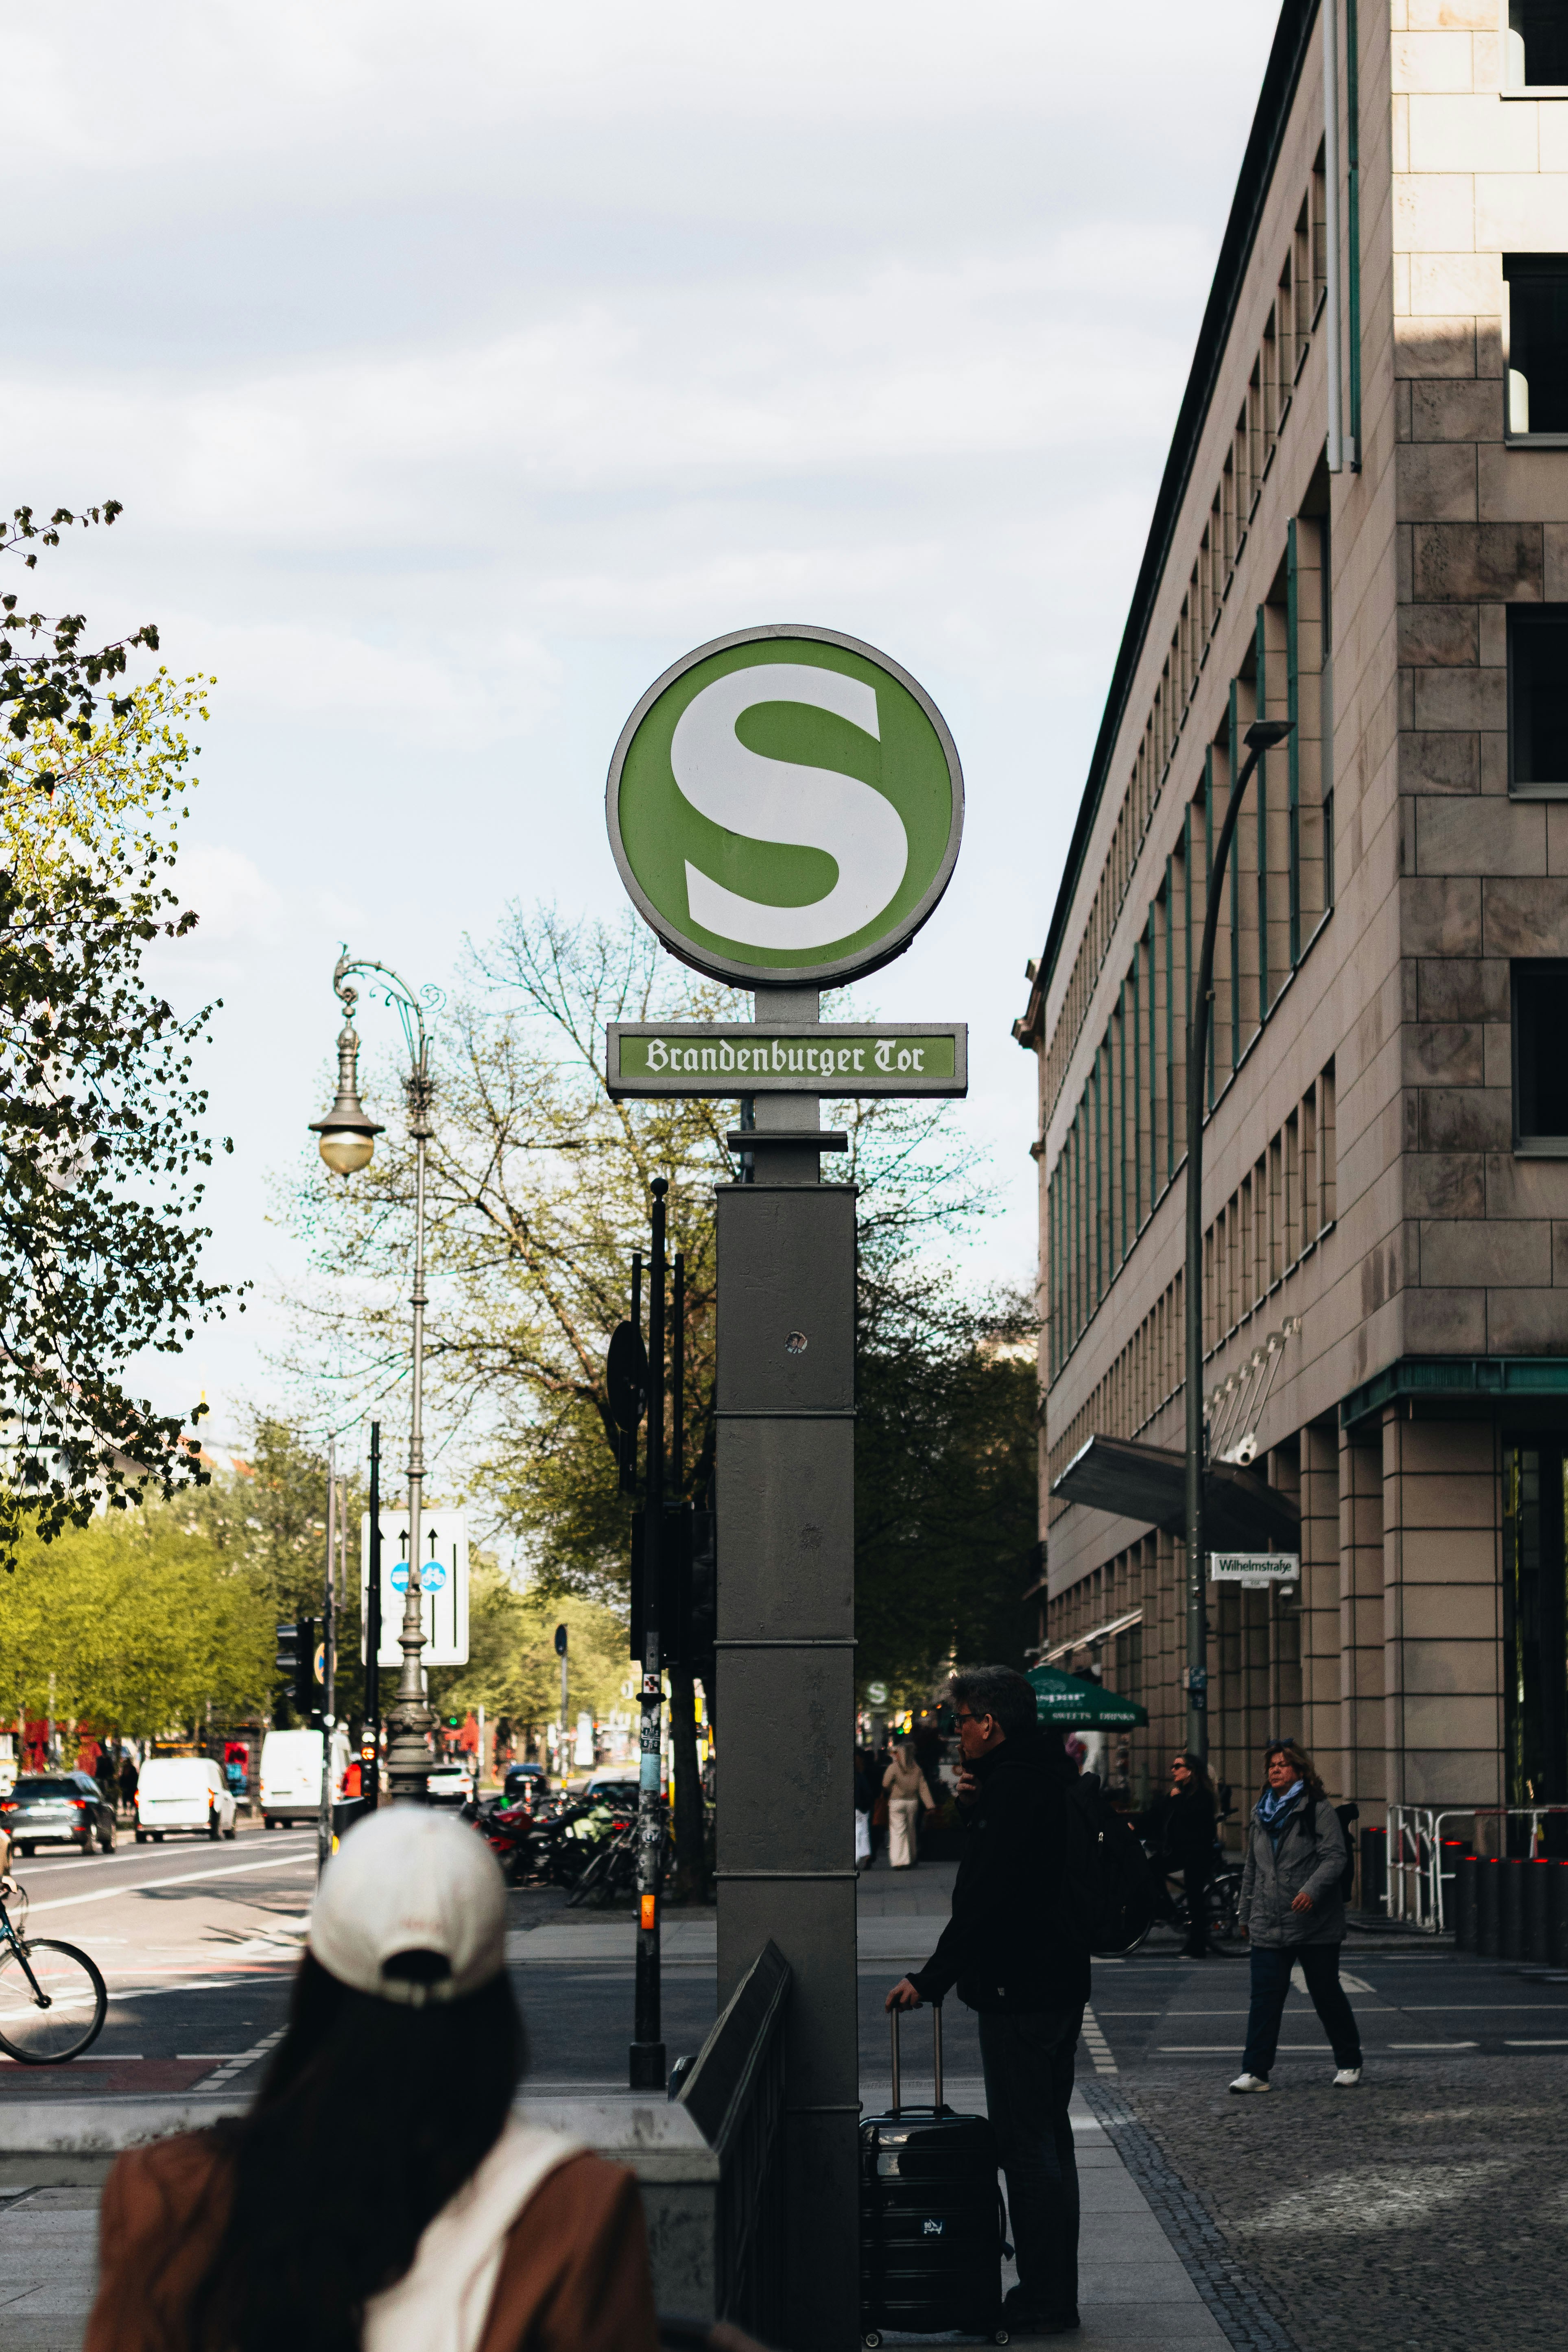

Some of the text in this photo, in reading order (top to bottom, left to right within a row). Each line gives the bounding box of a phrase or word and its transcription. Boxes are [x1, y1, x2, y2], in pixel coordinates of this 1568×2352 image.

[670, 663, 908, 950] S
[645, 1039, 924, 1077] Brandenburger Tor
[1219, 1559, 1292, 1574] Wilhelmstraße
[869, 1683, 885, 1703] S
